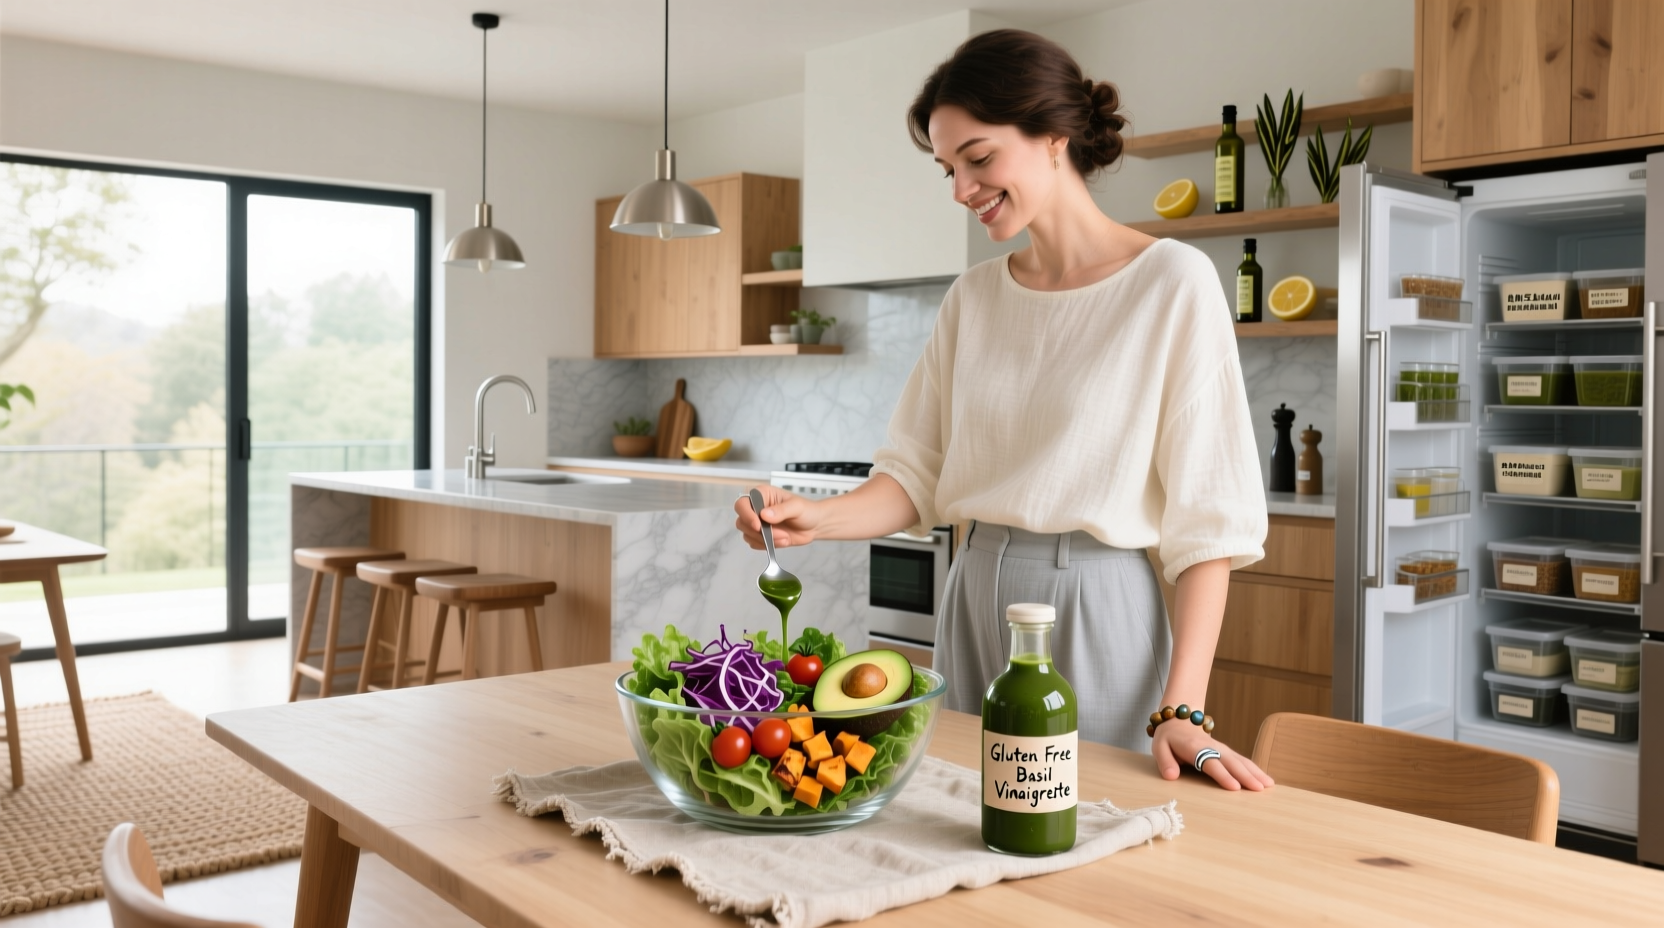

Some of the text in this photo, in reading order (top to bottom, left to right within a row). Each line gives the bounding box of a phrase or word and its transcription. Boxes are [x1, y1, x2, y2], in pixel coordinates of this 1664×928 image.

[990, 742, 1072, 763] Gluten Free
[1016, 766, 1052, 783] Basil
